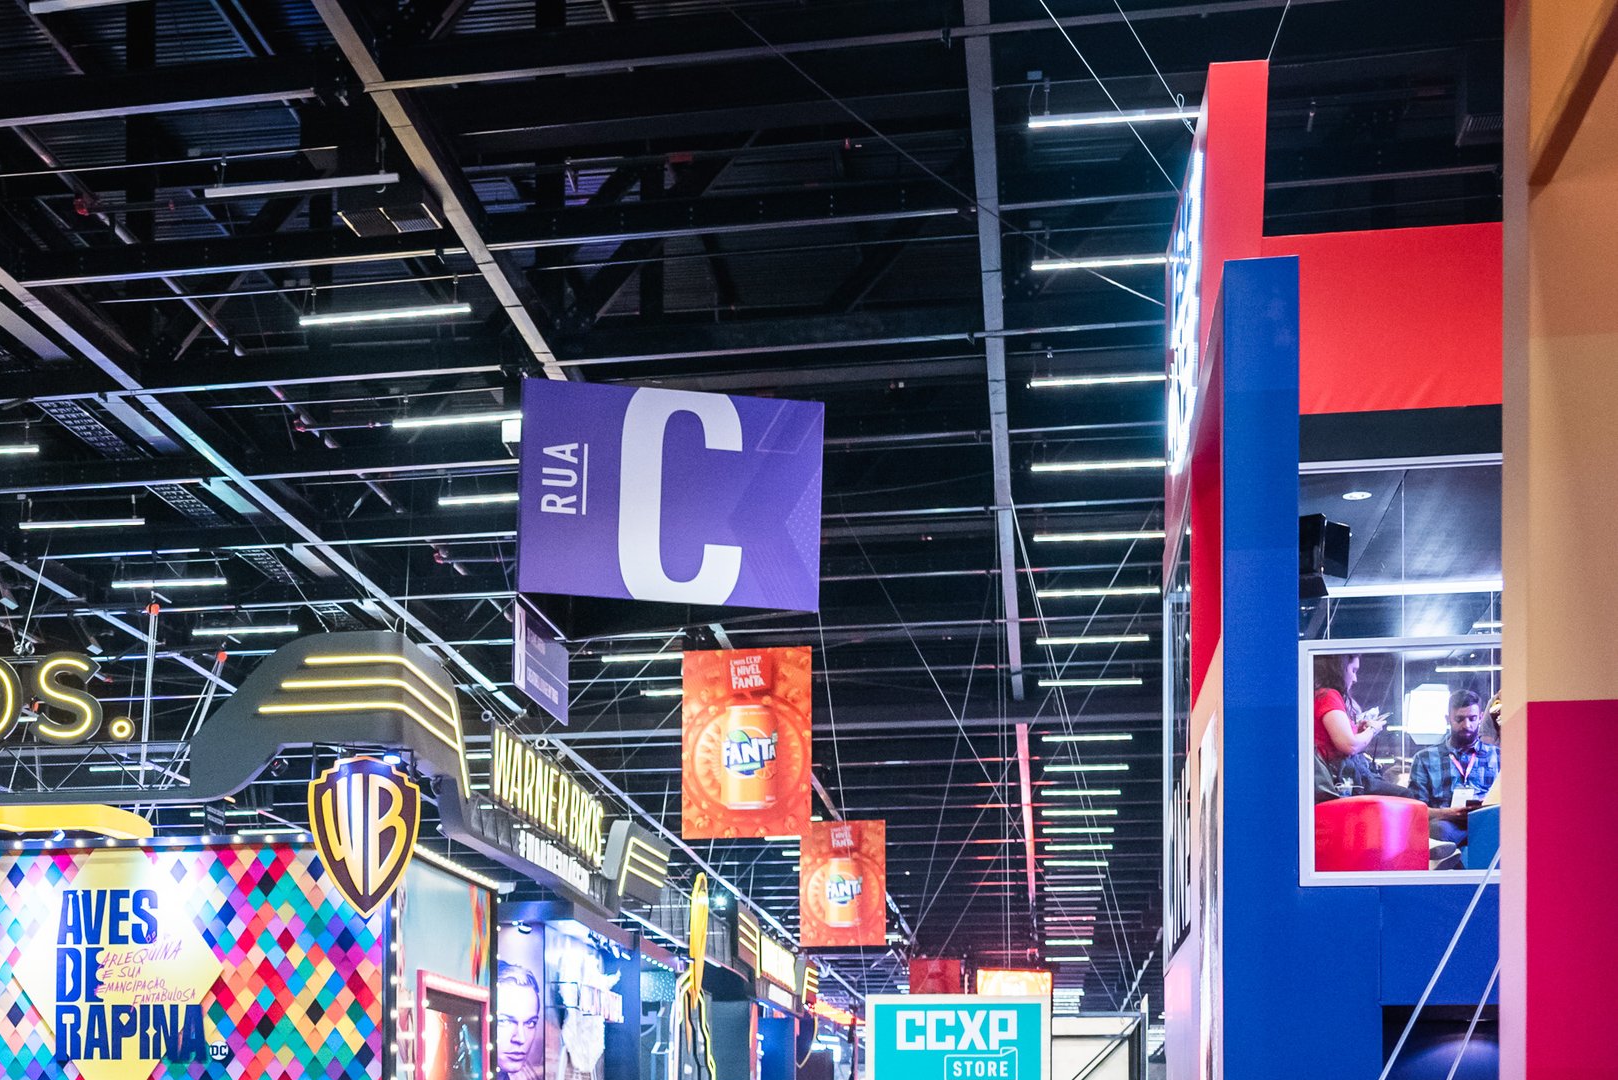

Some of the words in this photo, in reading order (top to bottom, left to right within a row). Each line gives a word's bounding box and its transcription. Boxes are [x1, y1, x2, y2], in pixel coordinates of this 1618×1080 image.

[541, 442, 579, 516] RUA
[618, 387, 744, 606] C
[732, 675, 767, 689] FANTA
[722, 737, 777, 767] FANTA
[494, 728, 569, 837] WARNER
[322, 773, 407, 896] WB
[827, 879, 862, 900] FANTA
[57, 889, 158, 945] AVES
[55, 1004, 208, 1061] RAPINA
[896, 1010, 1018, 1051] CCXP
[953, 1061, 1009, 1078] STORE
